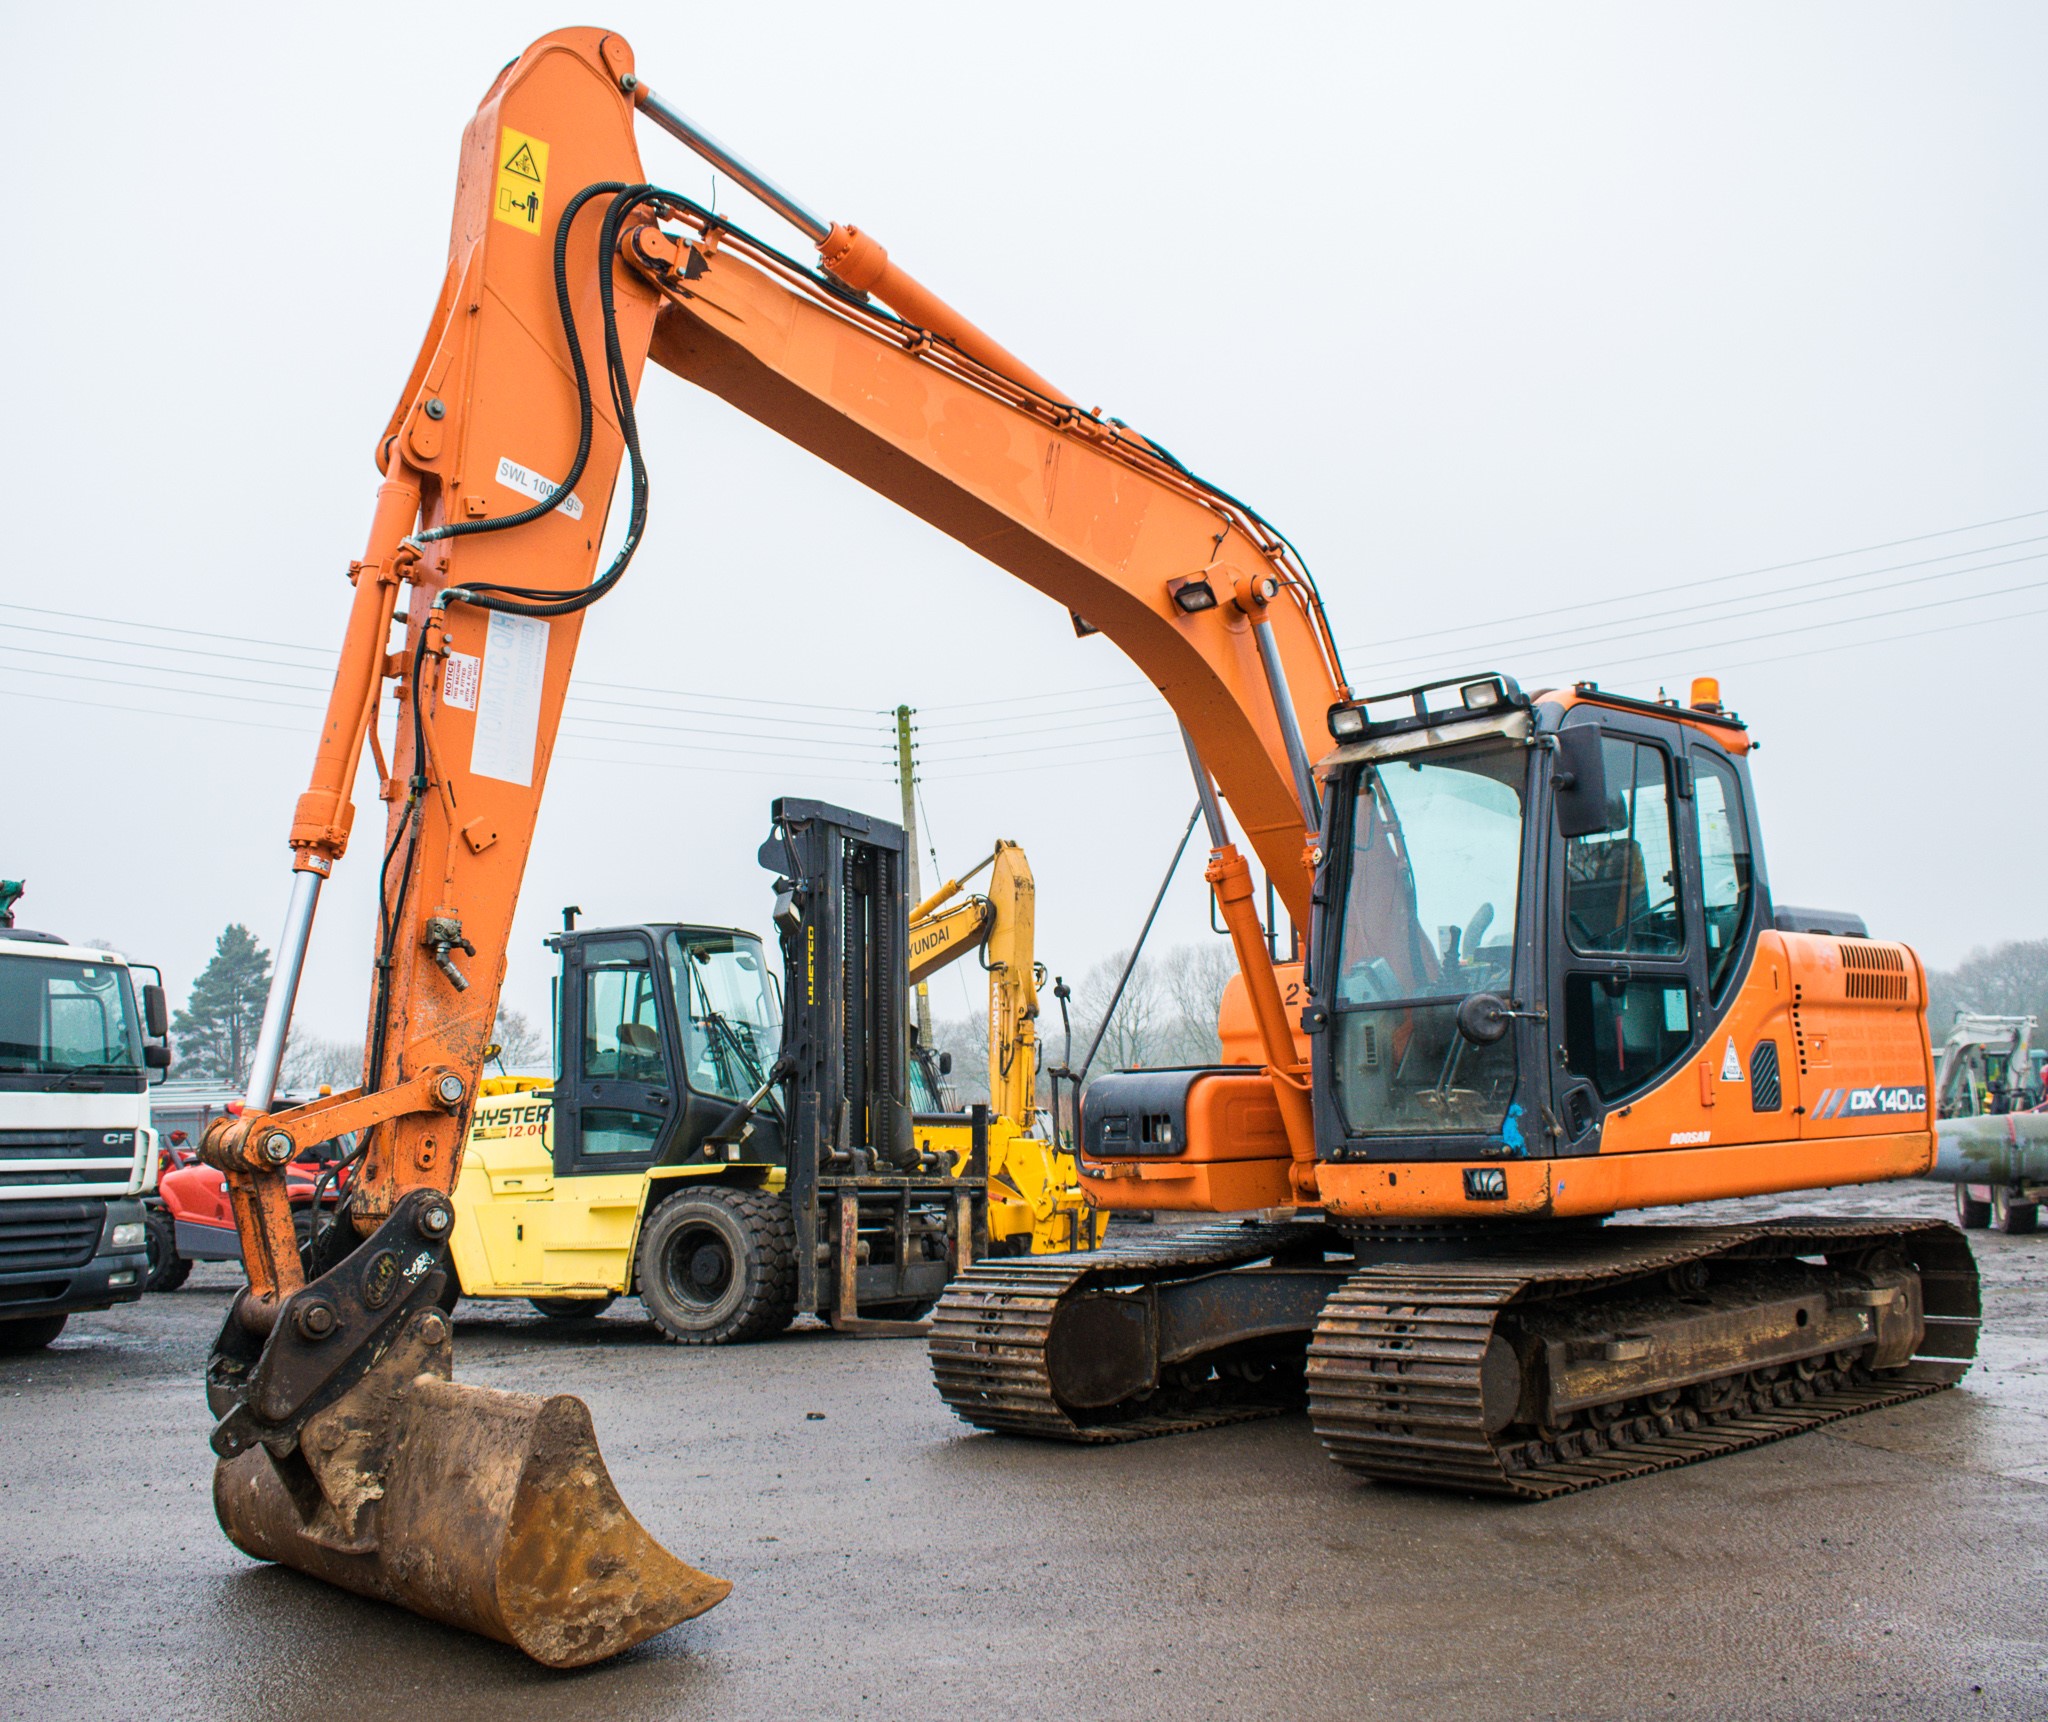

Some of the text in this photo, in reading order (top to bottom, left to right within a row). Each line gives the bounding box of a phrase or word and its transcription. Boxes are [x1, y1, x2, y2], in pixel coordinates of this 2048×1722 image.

[500, 462, 580, 512] SWL 100gs
[445, 660, 455, 696] NOTICE
[471, 1104, 552, 1127] HYSTER
[102, 1133, 133, 1145] CF
[508, 1124, 548, 1138] 12.00
[1669, 1130, 1712, 1145] DOOSAN
